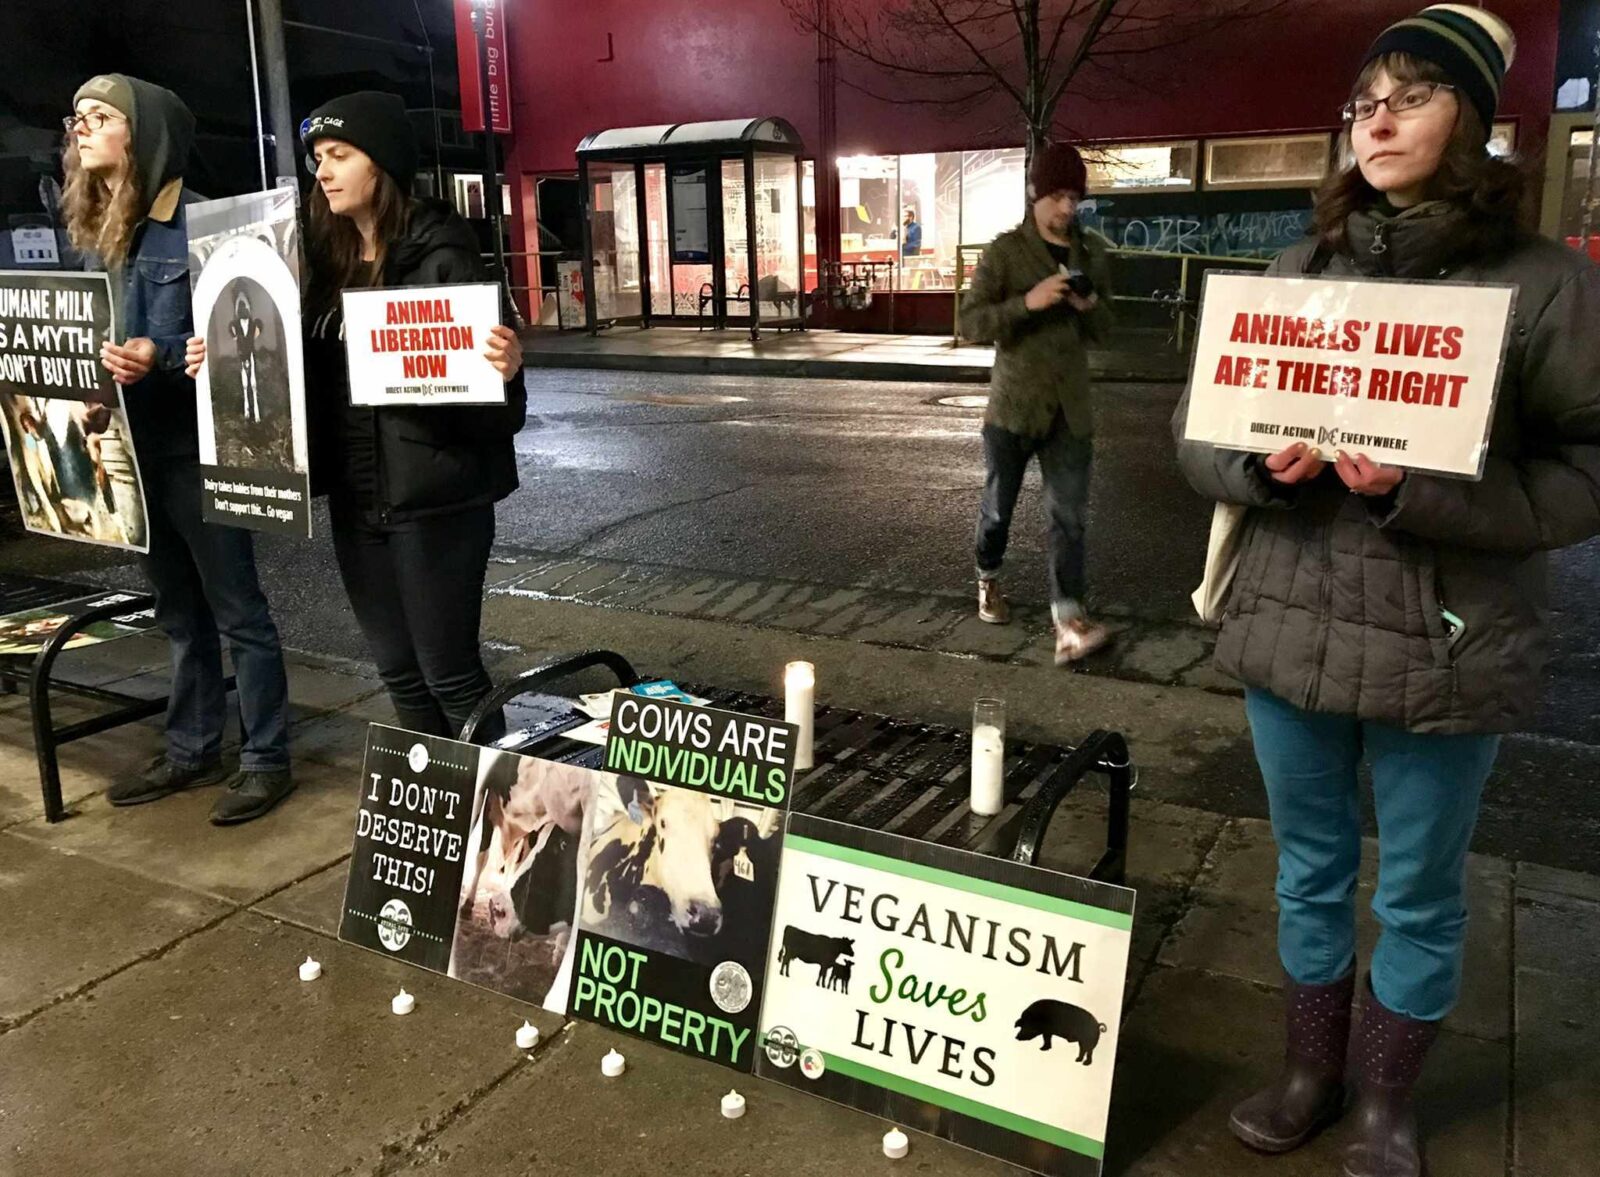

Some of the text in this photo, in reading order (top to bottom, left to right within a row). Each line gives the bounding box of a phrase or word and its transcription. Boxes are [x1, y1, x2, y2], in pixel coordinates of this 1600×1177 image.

[488, 47, 499, 76] big
[489, 84, 500, 122] little
[55, 290, 94, 322] MILK
[386, 299, 454, 325] ANIMAL
[13, 323, 29, 350] A
[32, 325, 94, 354] MYTH
[371, 326, 474, 353] LIBERATION
[1229, 312, 1464, 360] ANIMALS' LIVES
[41, 356, 72, 388] BUY
[76, 359, 100, 390] IT!
[403, 355, 447, 379] NOW
[1213, 355, 1469, 408] ARE THEIR RIGHT
[403, 386, 421, 394] ACTION
[434, 385, 469, 393] EVERYWHERE
[1250, 422, 1281, 436] DIRECT
[1282, 425, 1315, 440] ACTION
[1340, 432, 1408, 451] EVERYWHERE
[229, 502, 251, 516] support
[266, 504, 276, 518] Go
[275, 509, 294, 523] vegan
[249, 483, 264, 496] from
[263, 485, 277, 498] their
[277, 488, 302, 502] mothers
[617, 700, 789, 765] COWS ARE
[607, 736, 786, 804] INDIVIDUALS
[367, 772, 460, 820] I DON'T
[356, 808, 462, 862] DESERVE
[372, 852, 435, 896] THIS!
[806, 873, 1086, 984] VEGANISM
[580, 938, 648, 990] NOT
[869, 947, 987, 1023] Saves
[574, 975, 751, 1064] PROPERTY
[851, 1008, 996, 1087] LIVES
